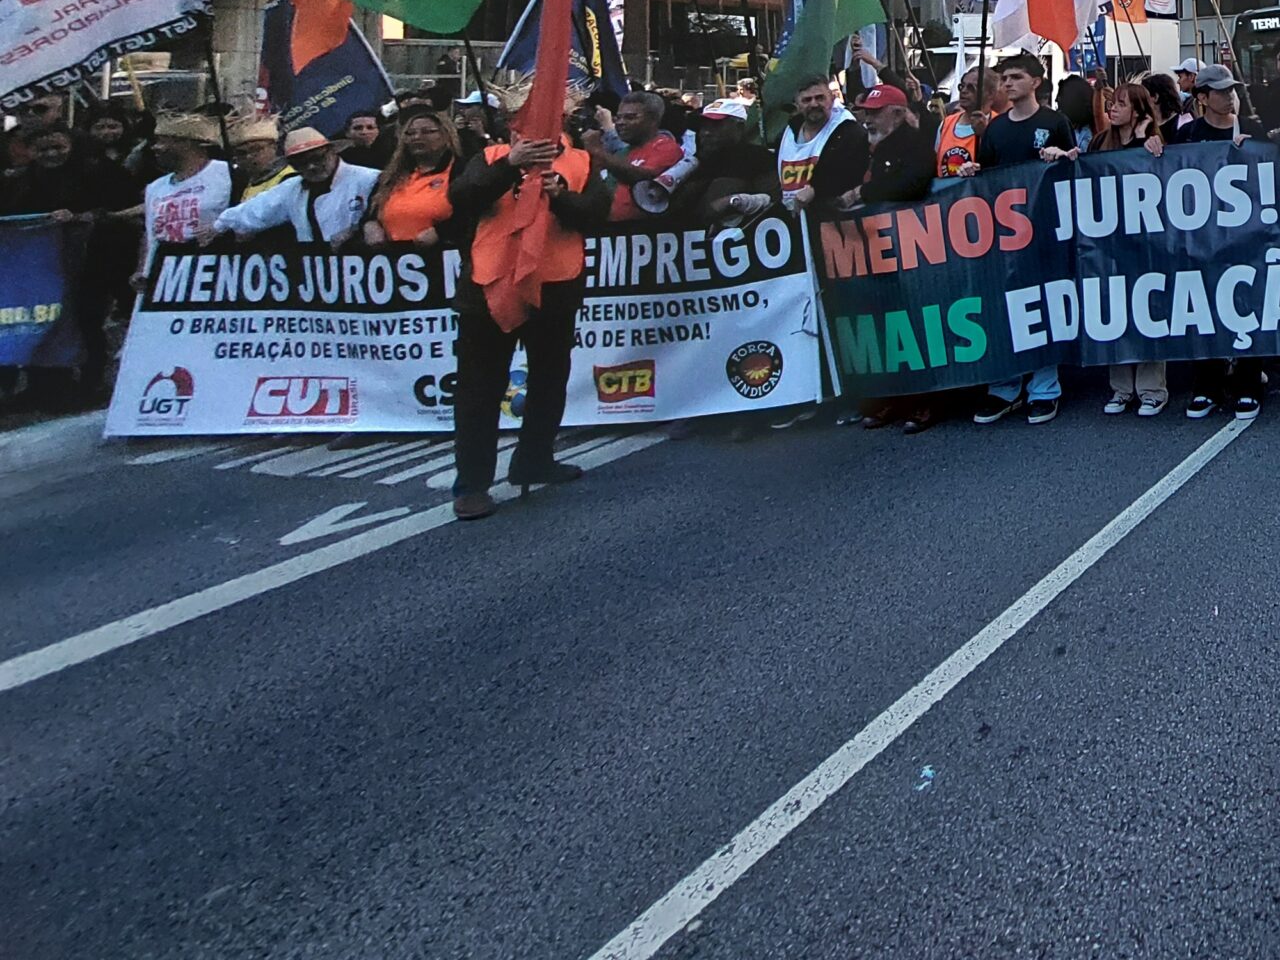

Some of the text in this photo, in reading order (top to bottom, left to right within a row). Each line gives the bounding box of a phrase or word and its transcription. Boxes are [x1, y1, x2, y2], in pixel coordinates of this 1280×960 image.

[820, 188, 1035, 280] MENOS
[1053, 161, 1279, 242] JUROS!
[152, 253, 290, 305] MENOS
[297, 253, 429, 305] JUROS
[584, 217, 792, 289] EMPREGO
[169, 318, 184, 334] O
[189, 317, 257, 335] BRASIL
[263, 317, 336, 336] PRECISA
[339, 319, 360, 336] DE
[215, 338, 306, 363] GERAÇÃO
[311, 343, 332, 359] DE
[336, 341, 423, 361] EMPREGO
[430, 342, 444, 358] E
[602, 329, 625, 349] DE
[630, 322, 712, 348] RENDA!
[835, 296, 988, 377] MAIS
[731, 342, 776, 364] FORÇA
[252, 378, 347, 416] CUT
[412, 372, 459, 408] CS
[598, 367, 652, 395] CTB
[731, 367, 782, 397] SINDICAL
[138, 397, 193, 416] UGT
